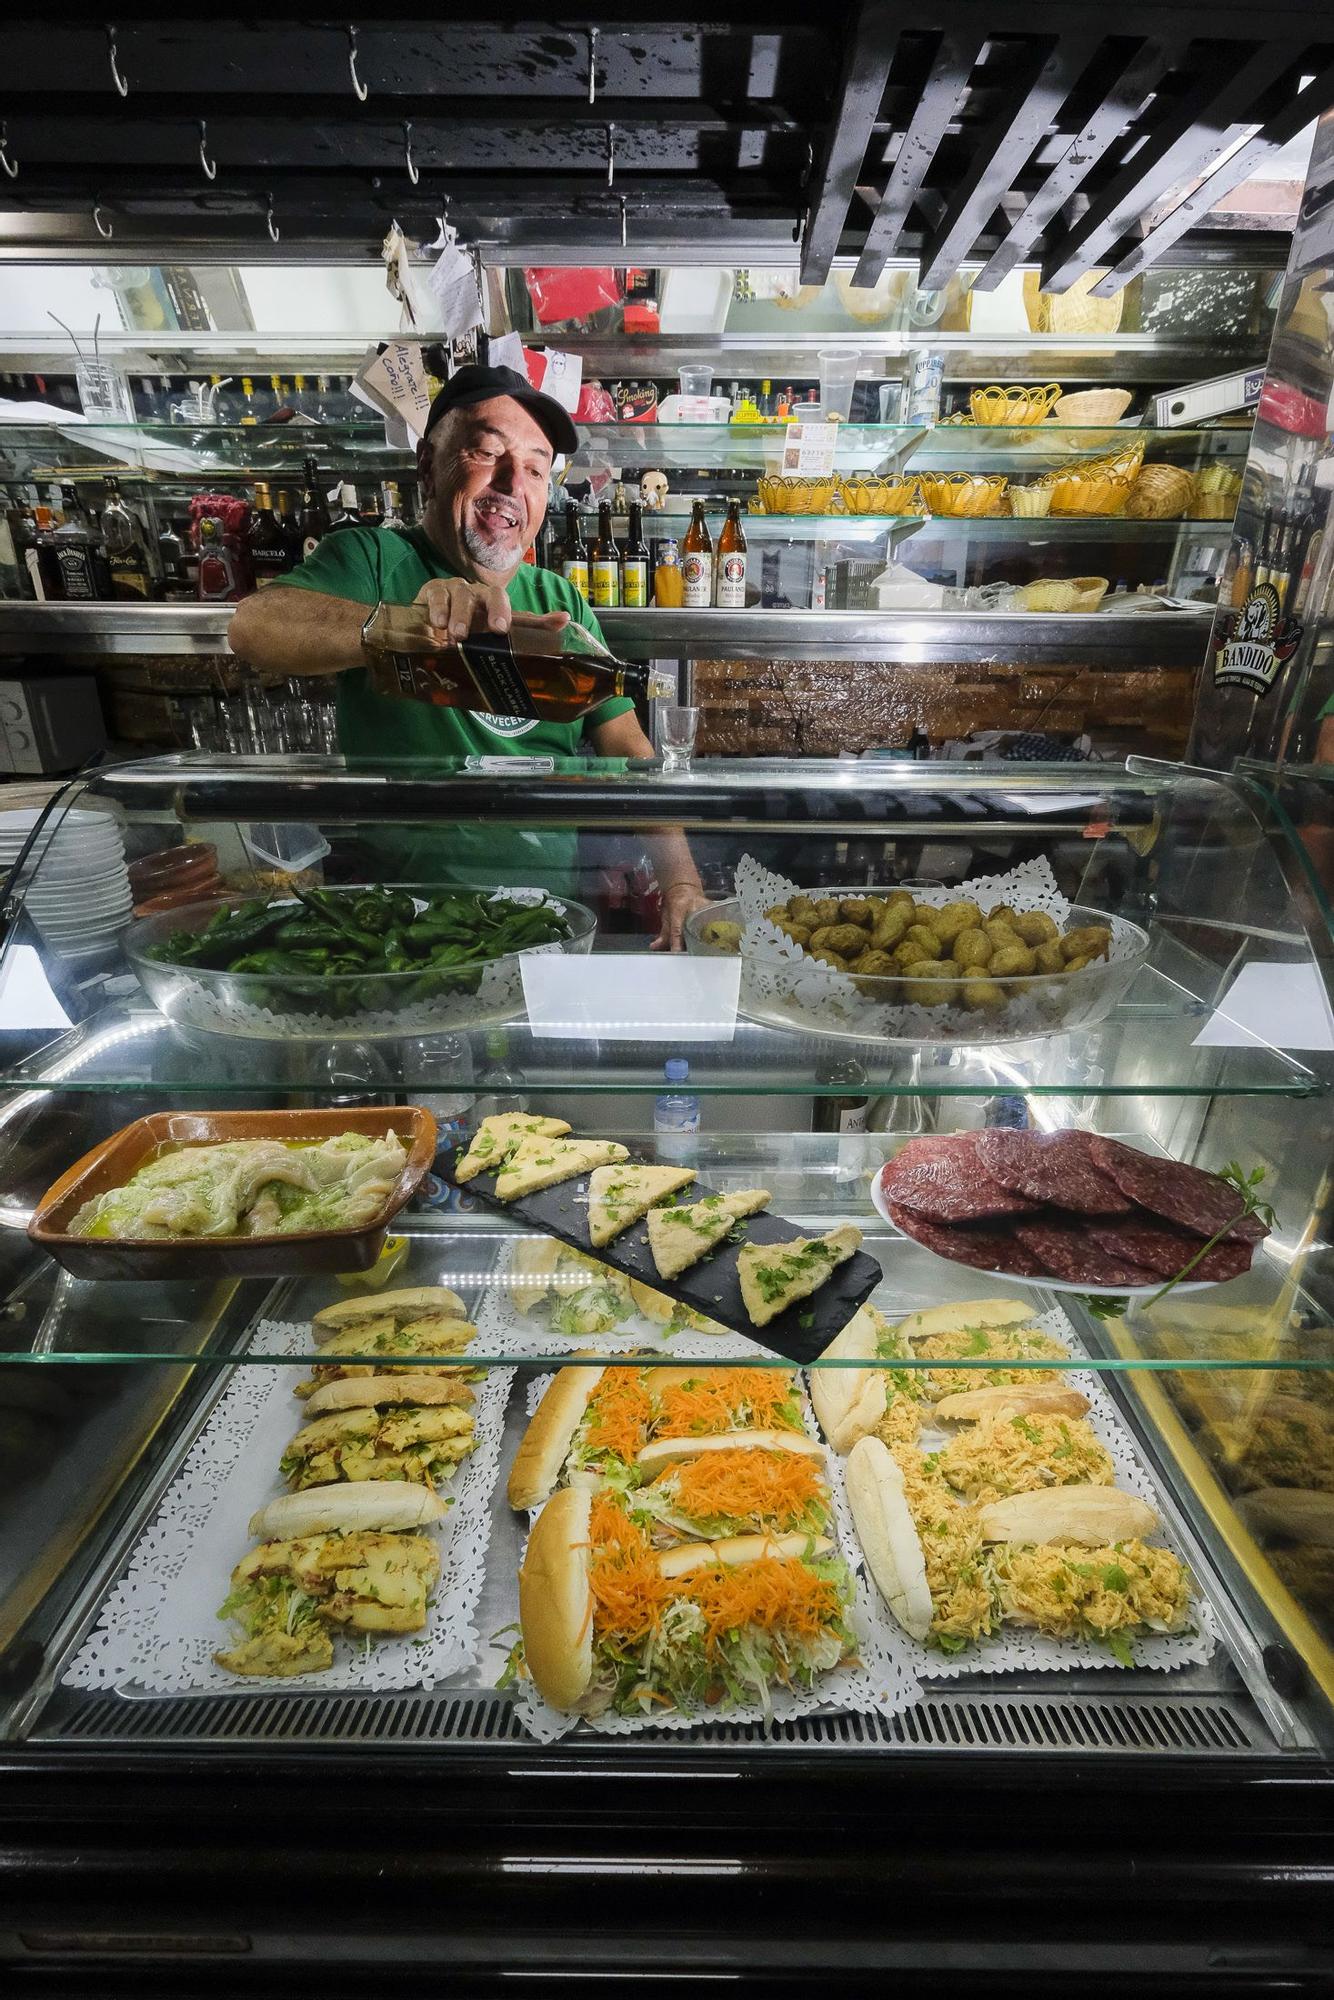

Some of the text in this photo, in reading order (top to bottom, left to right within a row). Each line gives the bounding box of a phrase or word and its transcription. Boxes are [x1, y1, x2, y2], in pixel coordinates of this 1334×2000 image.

[617, 387, 655, 407] Smoking
[252, 548, 286, 557] BARCELÓ
[1222, 647, 1275, 675] BANDIDO
[488, 655, 521, 715] BLACK LABEL
